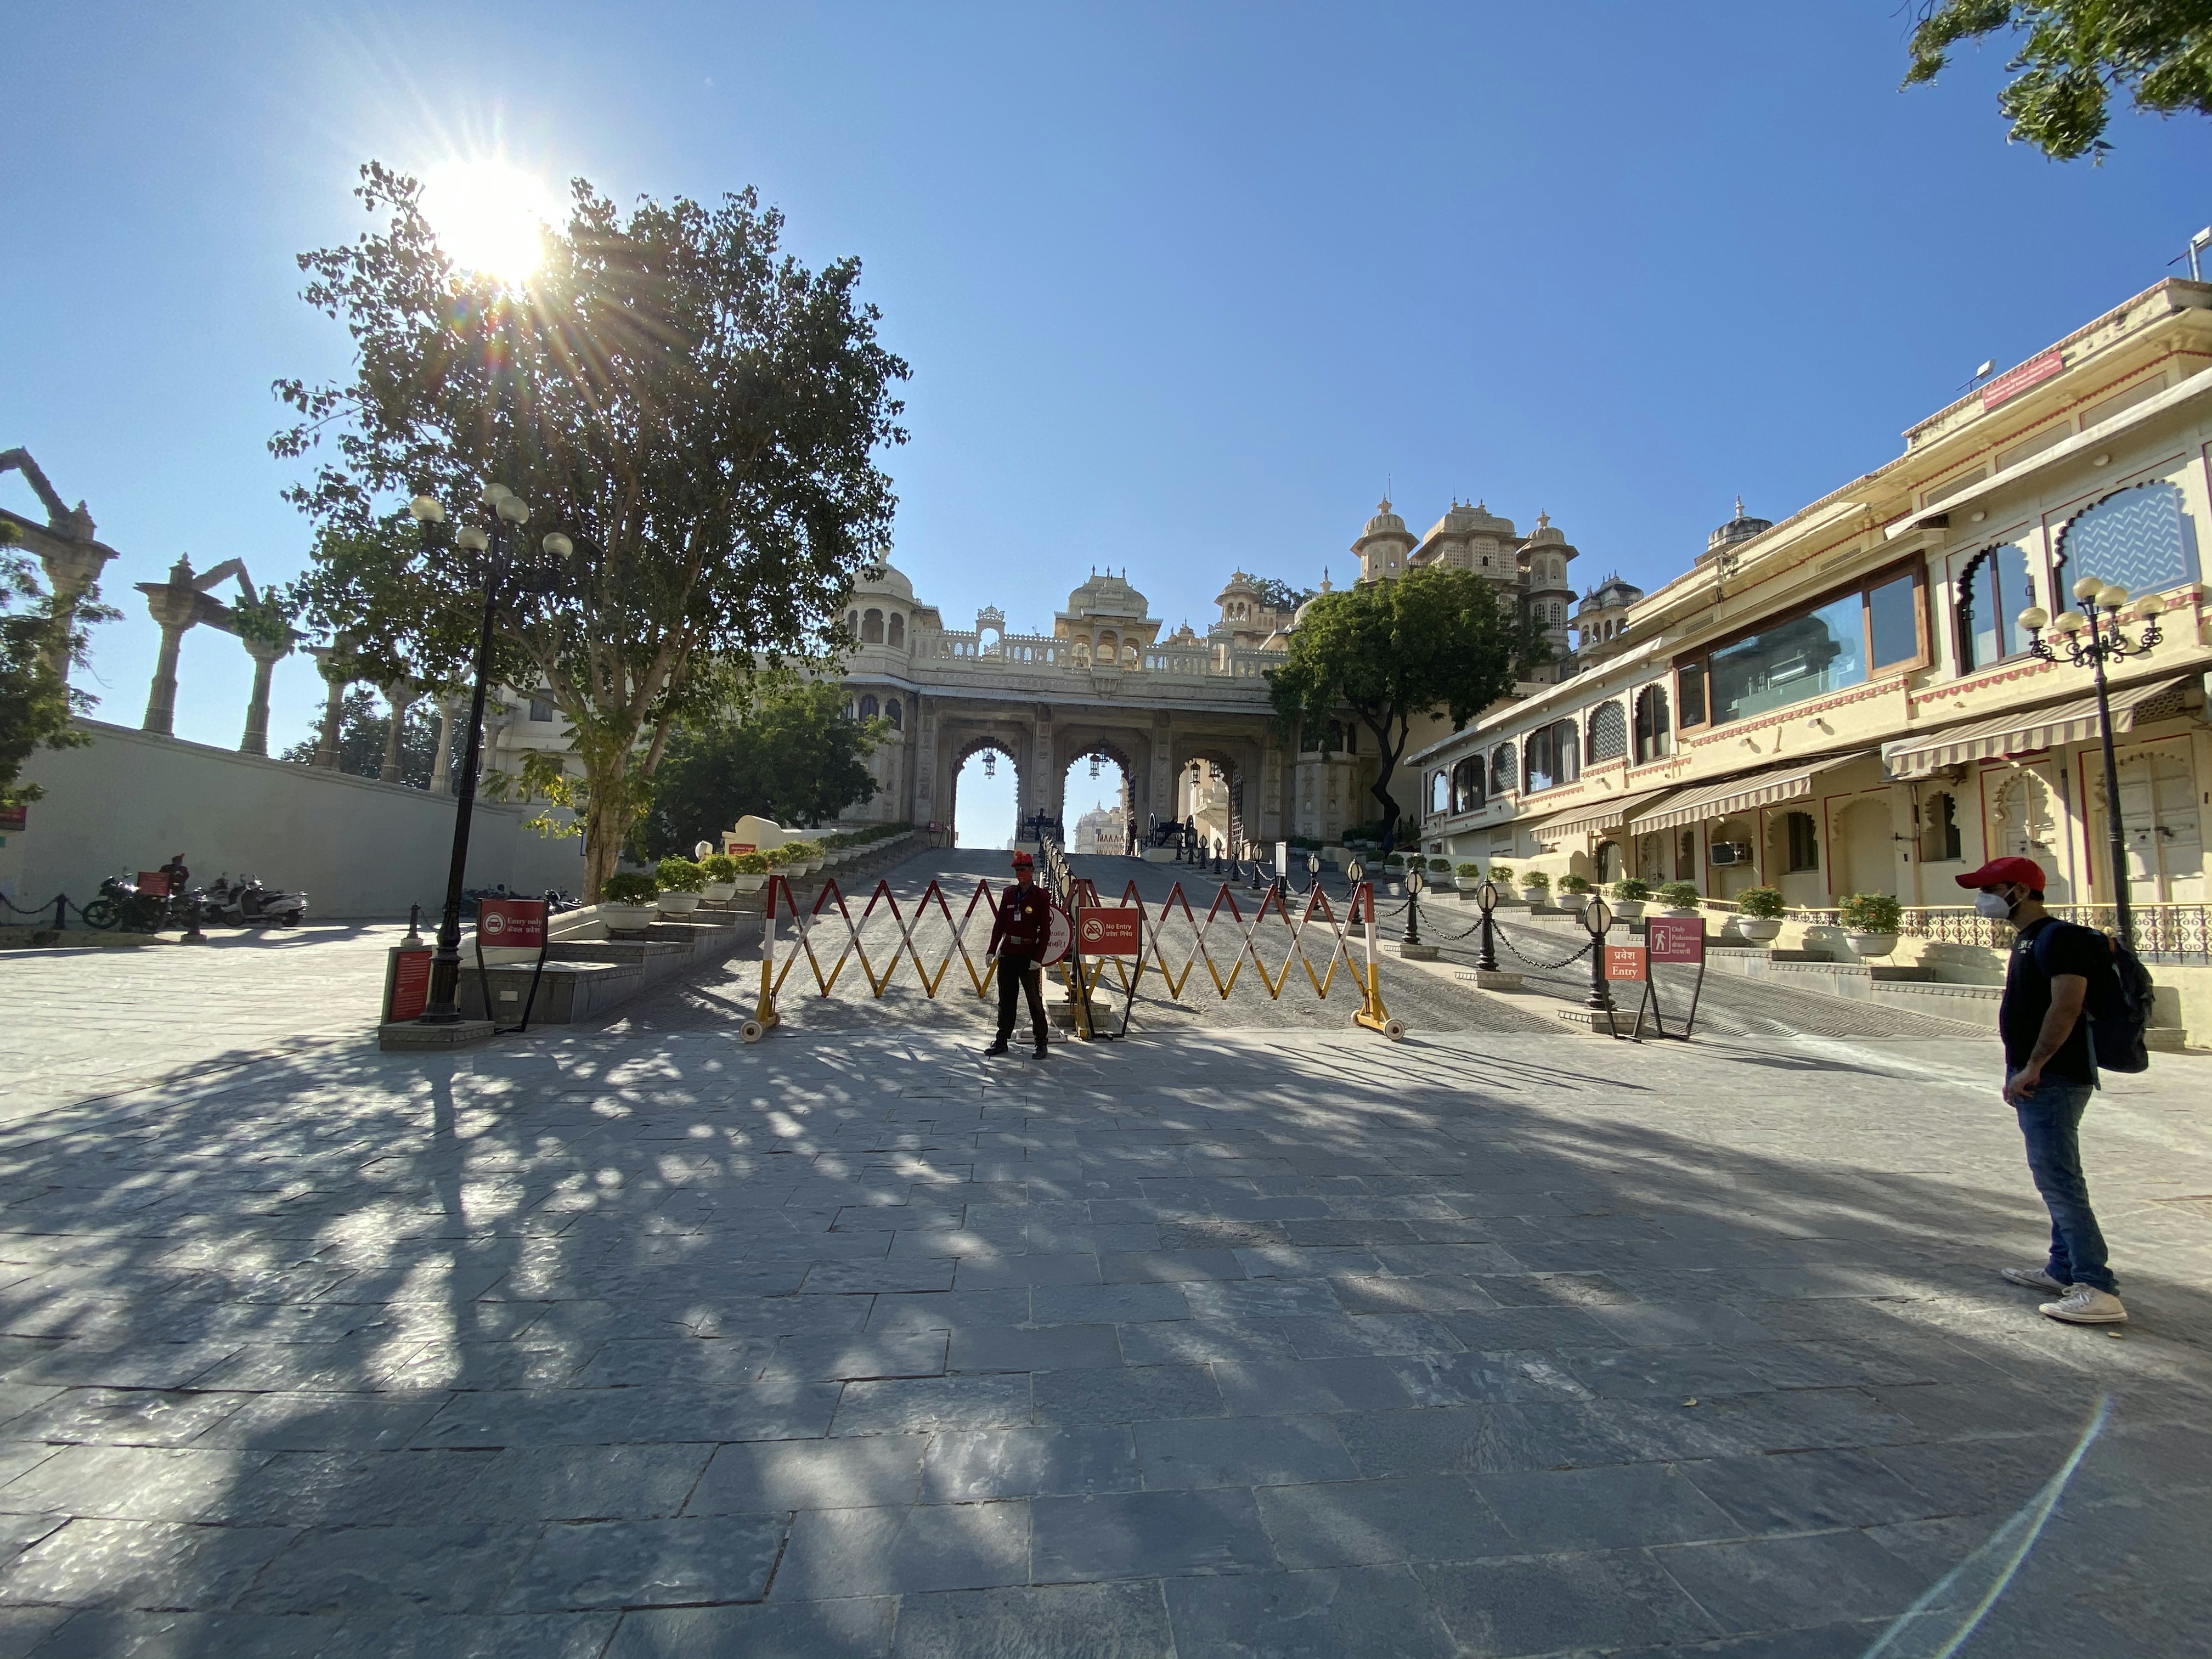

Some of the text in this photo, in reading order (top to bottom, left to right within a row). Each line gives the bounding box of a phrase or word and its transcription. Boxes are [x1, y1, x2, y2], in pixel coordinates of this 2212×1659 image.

[507, 917, 541, 927] Entry only
[1614, 949, 1636, 960] प्रवेश
[1612, 966, 1638, 978] Entry
